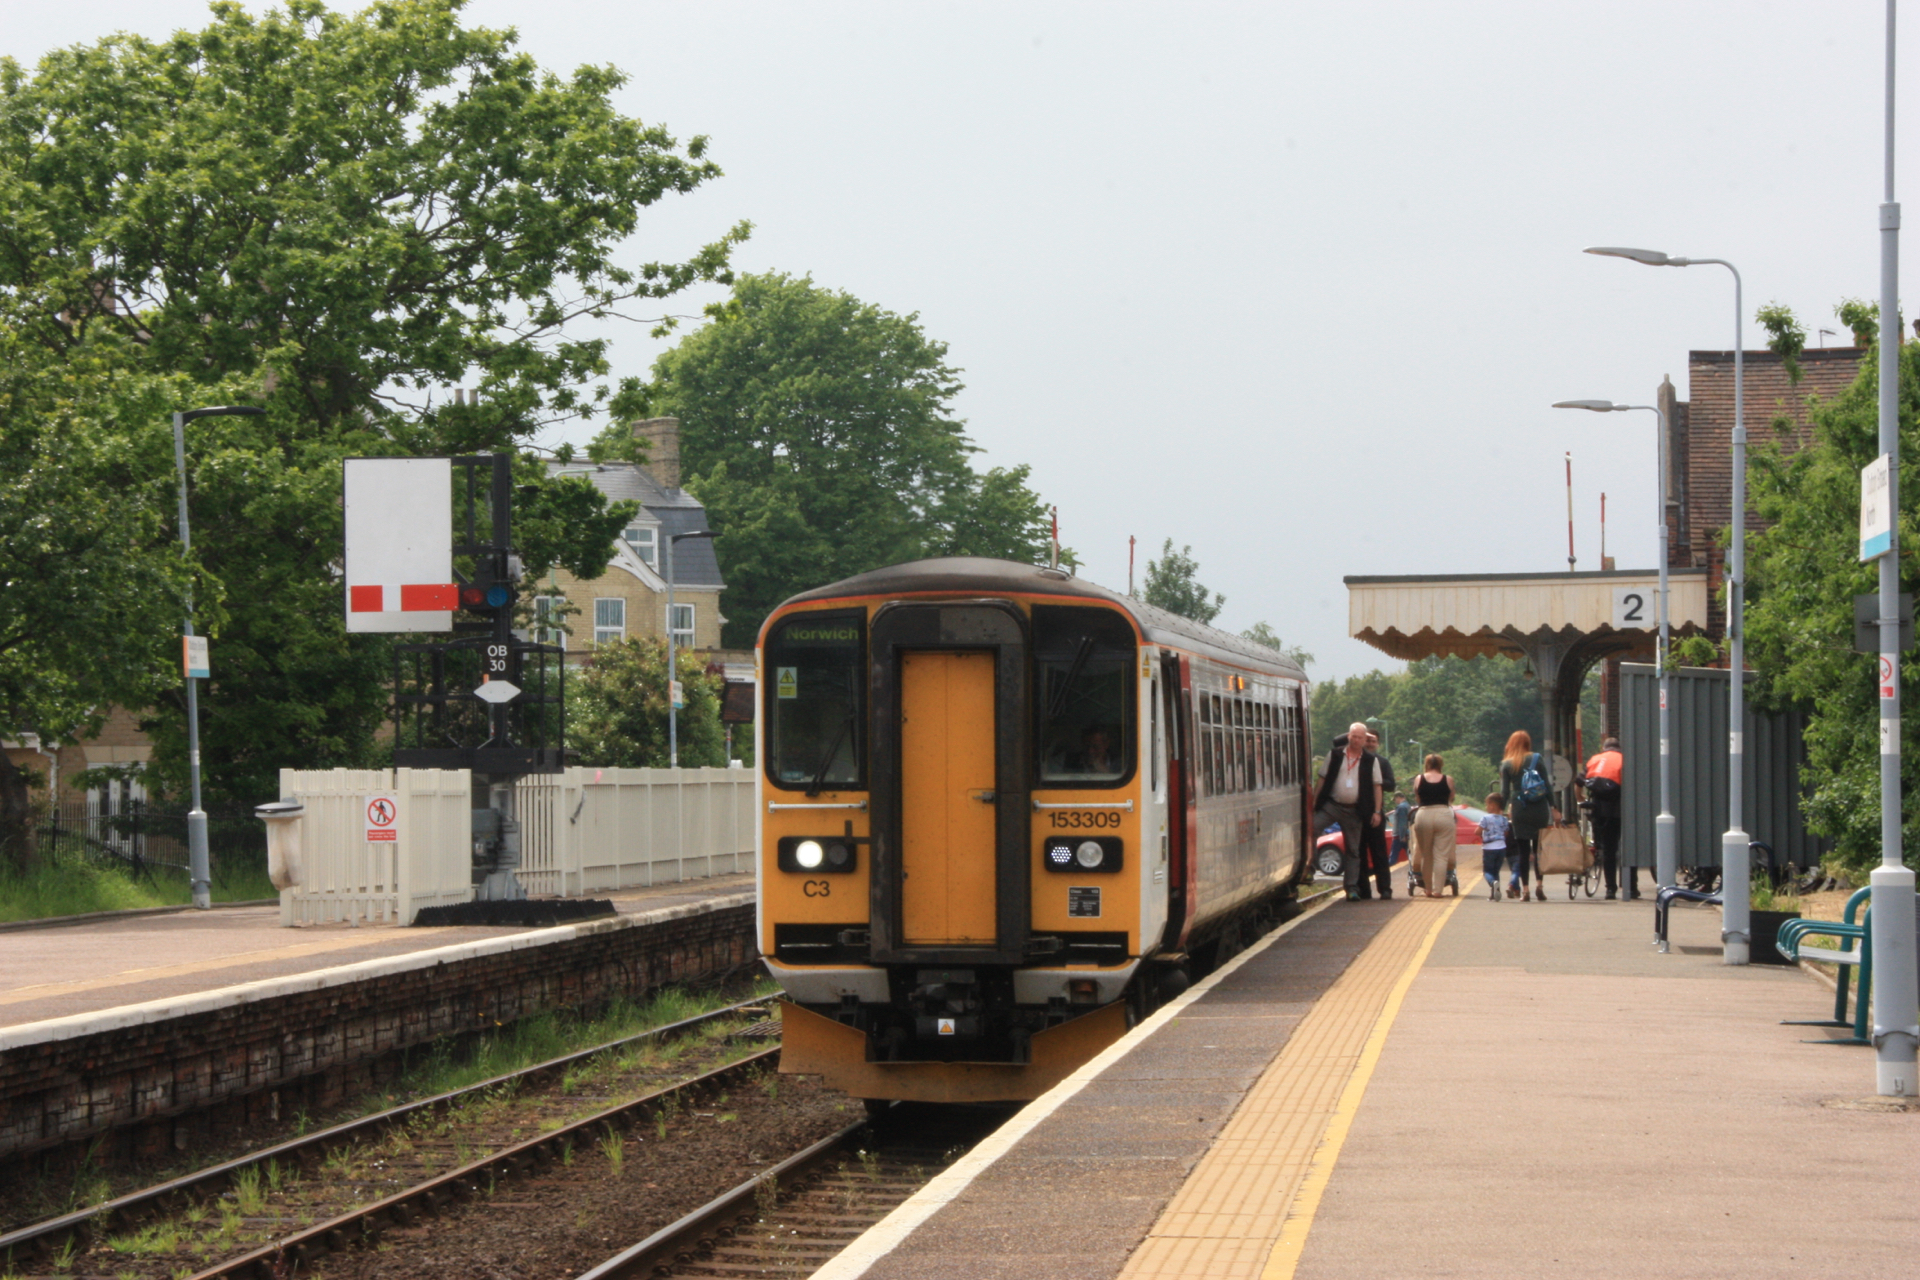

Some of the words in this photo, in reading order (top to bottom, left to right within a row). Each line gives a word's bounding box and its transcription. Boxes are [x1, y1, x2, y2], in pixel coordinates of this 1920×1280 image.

[1623, 593, 1643, 621] 2
[786, 627, 859, 640] Norwich
[487, 645, 508, 657] OB
[489, 660, 506, 672] 30
[1048, 812, 1121, 828] 153309
[803, 880, 831, 897] C3
